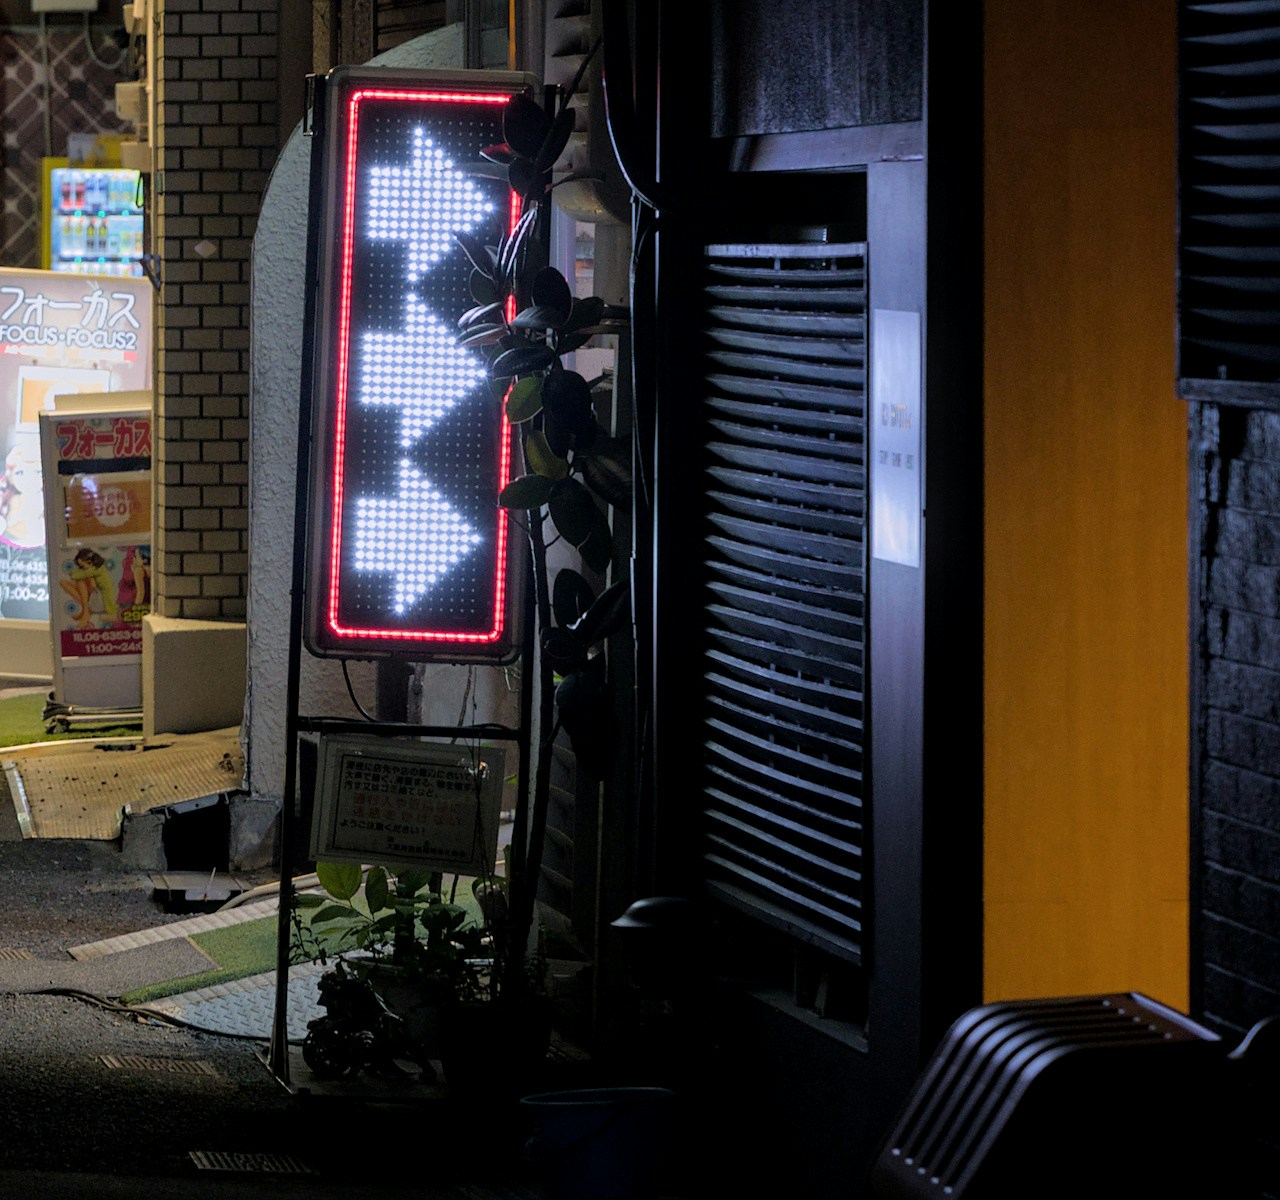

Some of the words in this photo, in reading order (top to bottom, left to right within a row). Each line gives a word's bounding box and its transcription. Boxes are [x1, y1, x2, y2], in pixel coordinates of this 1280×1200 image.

[0, 285, 141, 330] フォーカス
[56, 419, 152, 460] フォーカス
